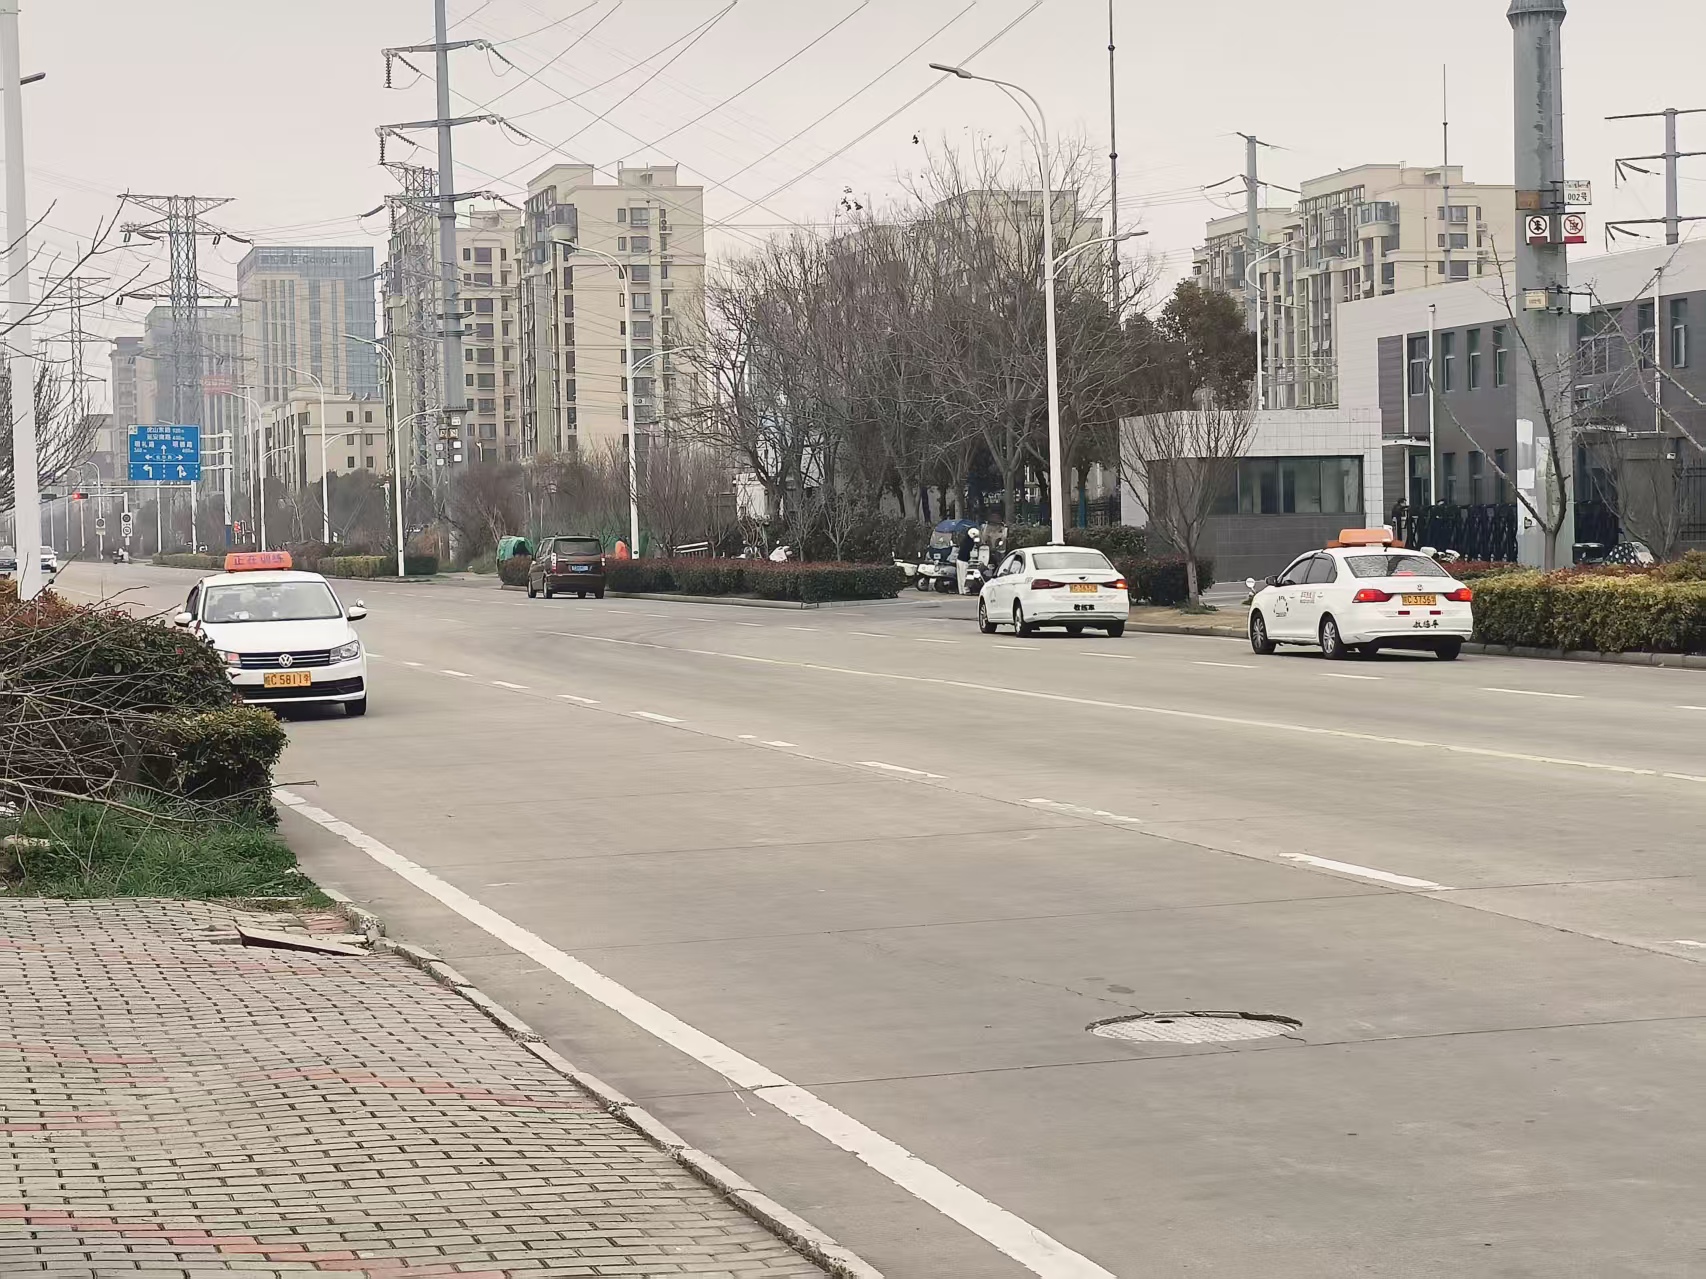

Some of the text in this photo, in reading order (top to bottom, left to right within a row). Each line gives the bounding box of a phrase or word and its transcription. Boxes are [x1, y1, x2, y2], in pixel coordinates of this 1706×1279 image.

[1568, 192, 1588, 201] 002号
[232, 553, 285, 566] 正在训练
